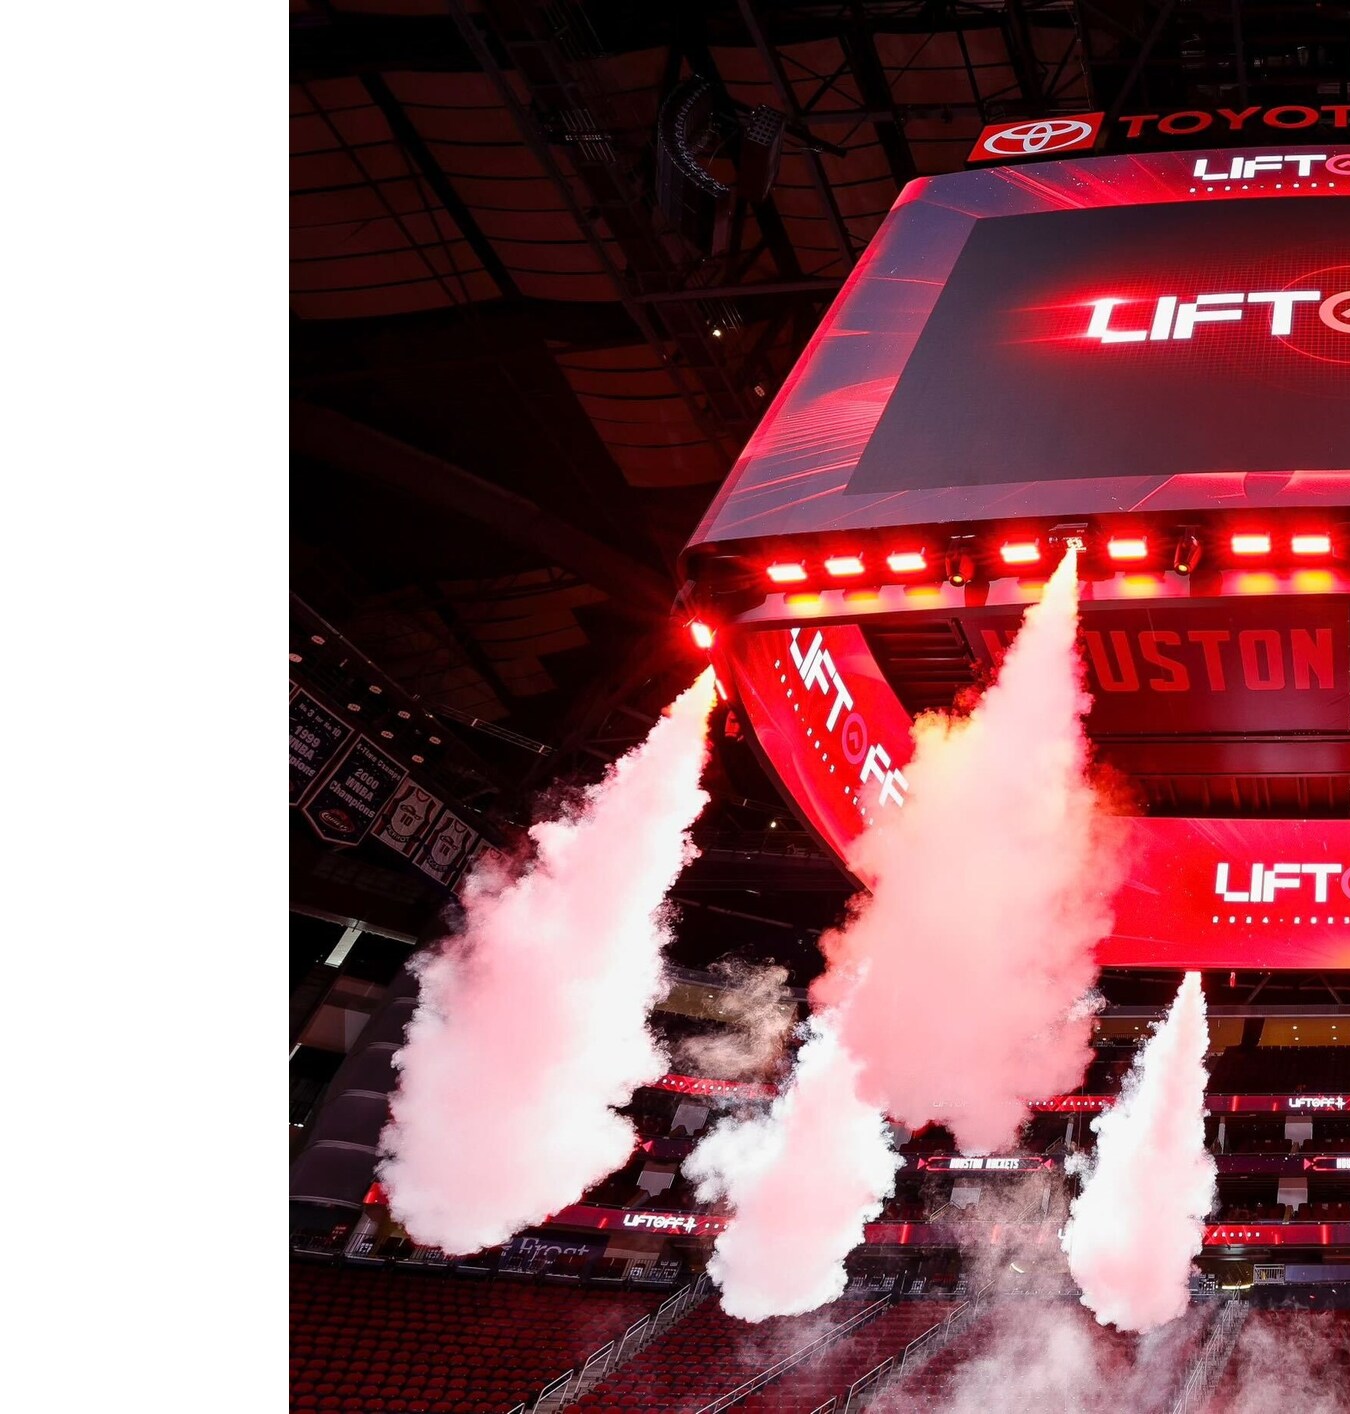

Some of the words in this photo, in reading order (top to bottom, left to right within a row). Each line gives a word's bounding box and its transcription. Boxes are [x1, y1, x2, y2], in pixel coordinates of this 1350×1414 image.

[790, 627, 910, 808] LIFTOFF
[294, 725, 321, 748] 1999
[345, 775, 374, 801] WNBA
[354, 767, 380, 790] 2000
[328, 779, 377, 819] Champions
[400, 813, 413, 826] 10
